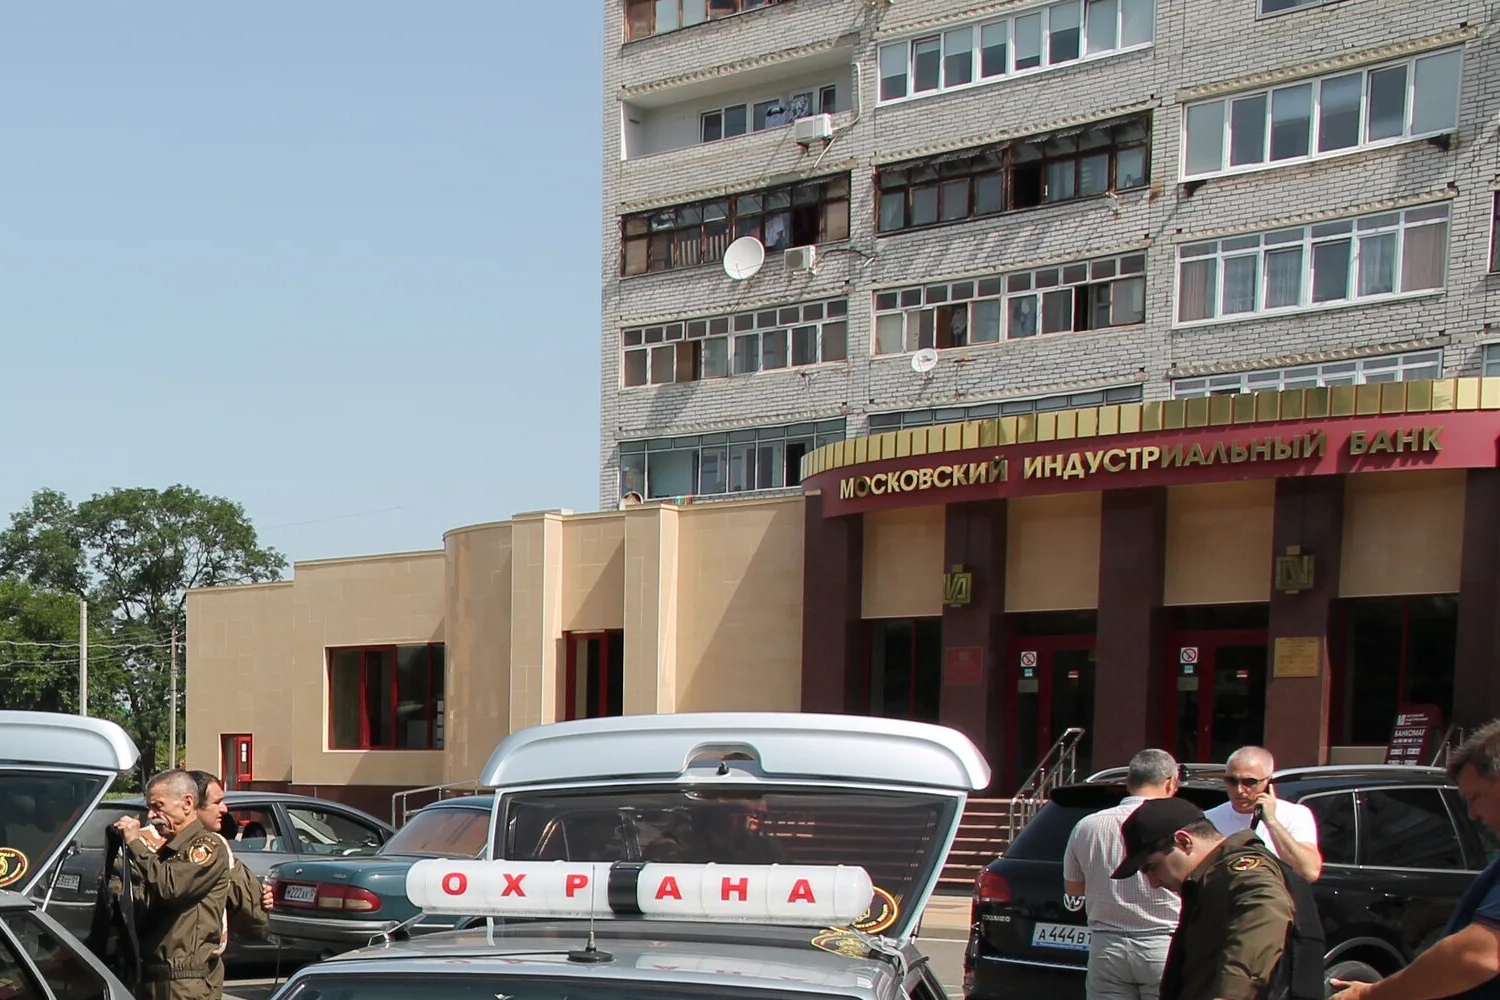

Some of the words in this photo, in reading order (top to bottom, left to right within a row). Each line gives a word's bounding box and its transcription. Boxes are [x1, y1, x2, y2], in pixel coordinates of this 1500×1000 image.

[839, 454, 1009, 500] МОСКОВСКИЙ
[1023, 428, 1327, 481] ИНДУСТРИАЛЬНЫЙ
[1349, 425, 1445, 456] БАНК
[1394, 728, 1426, 738] БАНКОМАТ
[441, 872, 817, 904] ОХРАНА
